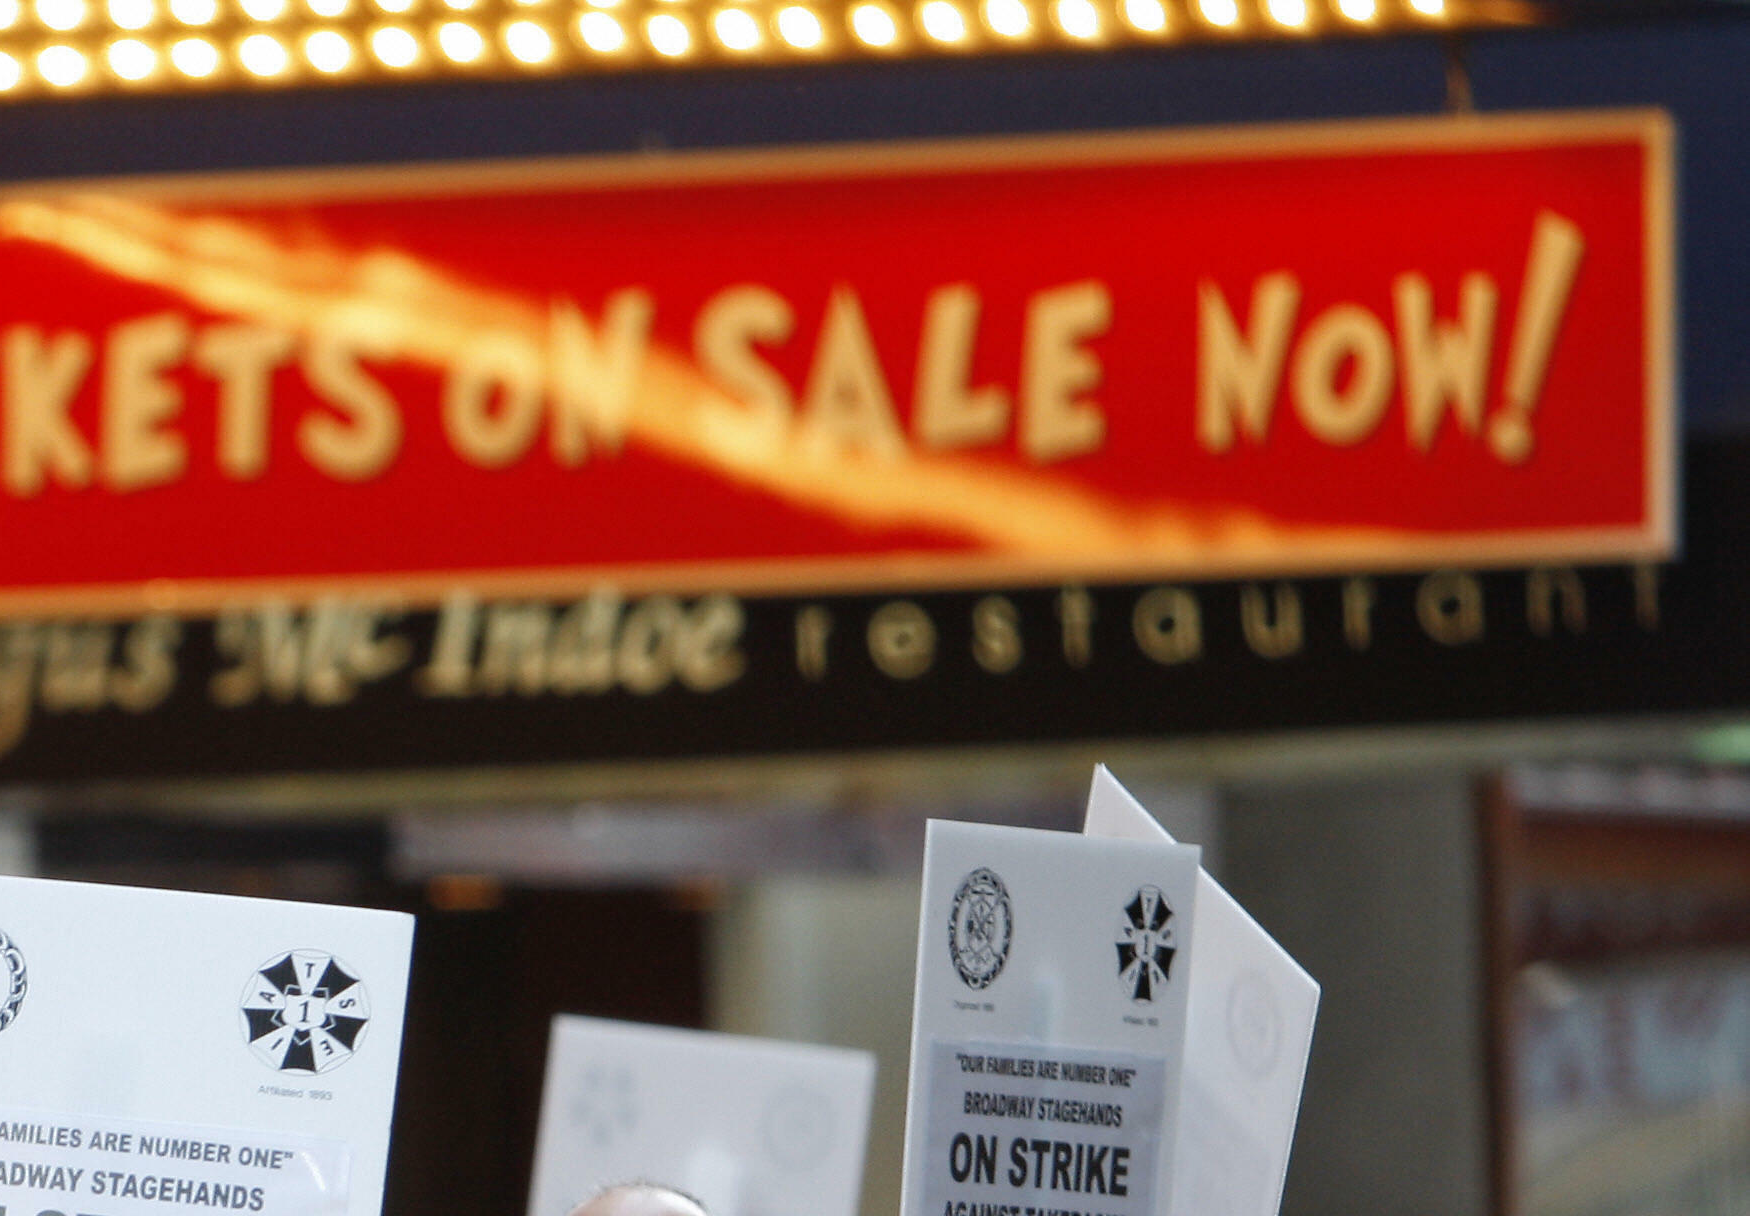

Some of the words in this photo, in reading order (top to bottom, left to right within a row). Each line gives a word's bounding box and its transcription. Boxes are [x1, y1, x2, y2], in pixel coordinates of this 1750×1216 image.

[445, 293, 650, 474] ON
[690, 279, 1109, 464] SALE
[985, 1055, 1035, 1078] FAMILIES
[1036, 1059, 1059, 1080] ARE
[1060, 1062, 1106, 1084] NUMBER
[963, 1090, 1035, 1119] BROADWAY
[1037, 1097, 1122, 1128] STAGEHANDS
[88, 1130, 132, 1153] ARE
[138, 1135, 231, 1164] NUMBER
[948, 1131, 998, 1185] ON
[1007, 1136, 1130, 1197] STRIKE
[90, 1170, 264, 1212] STAGEHANDS
